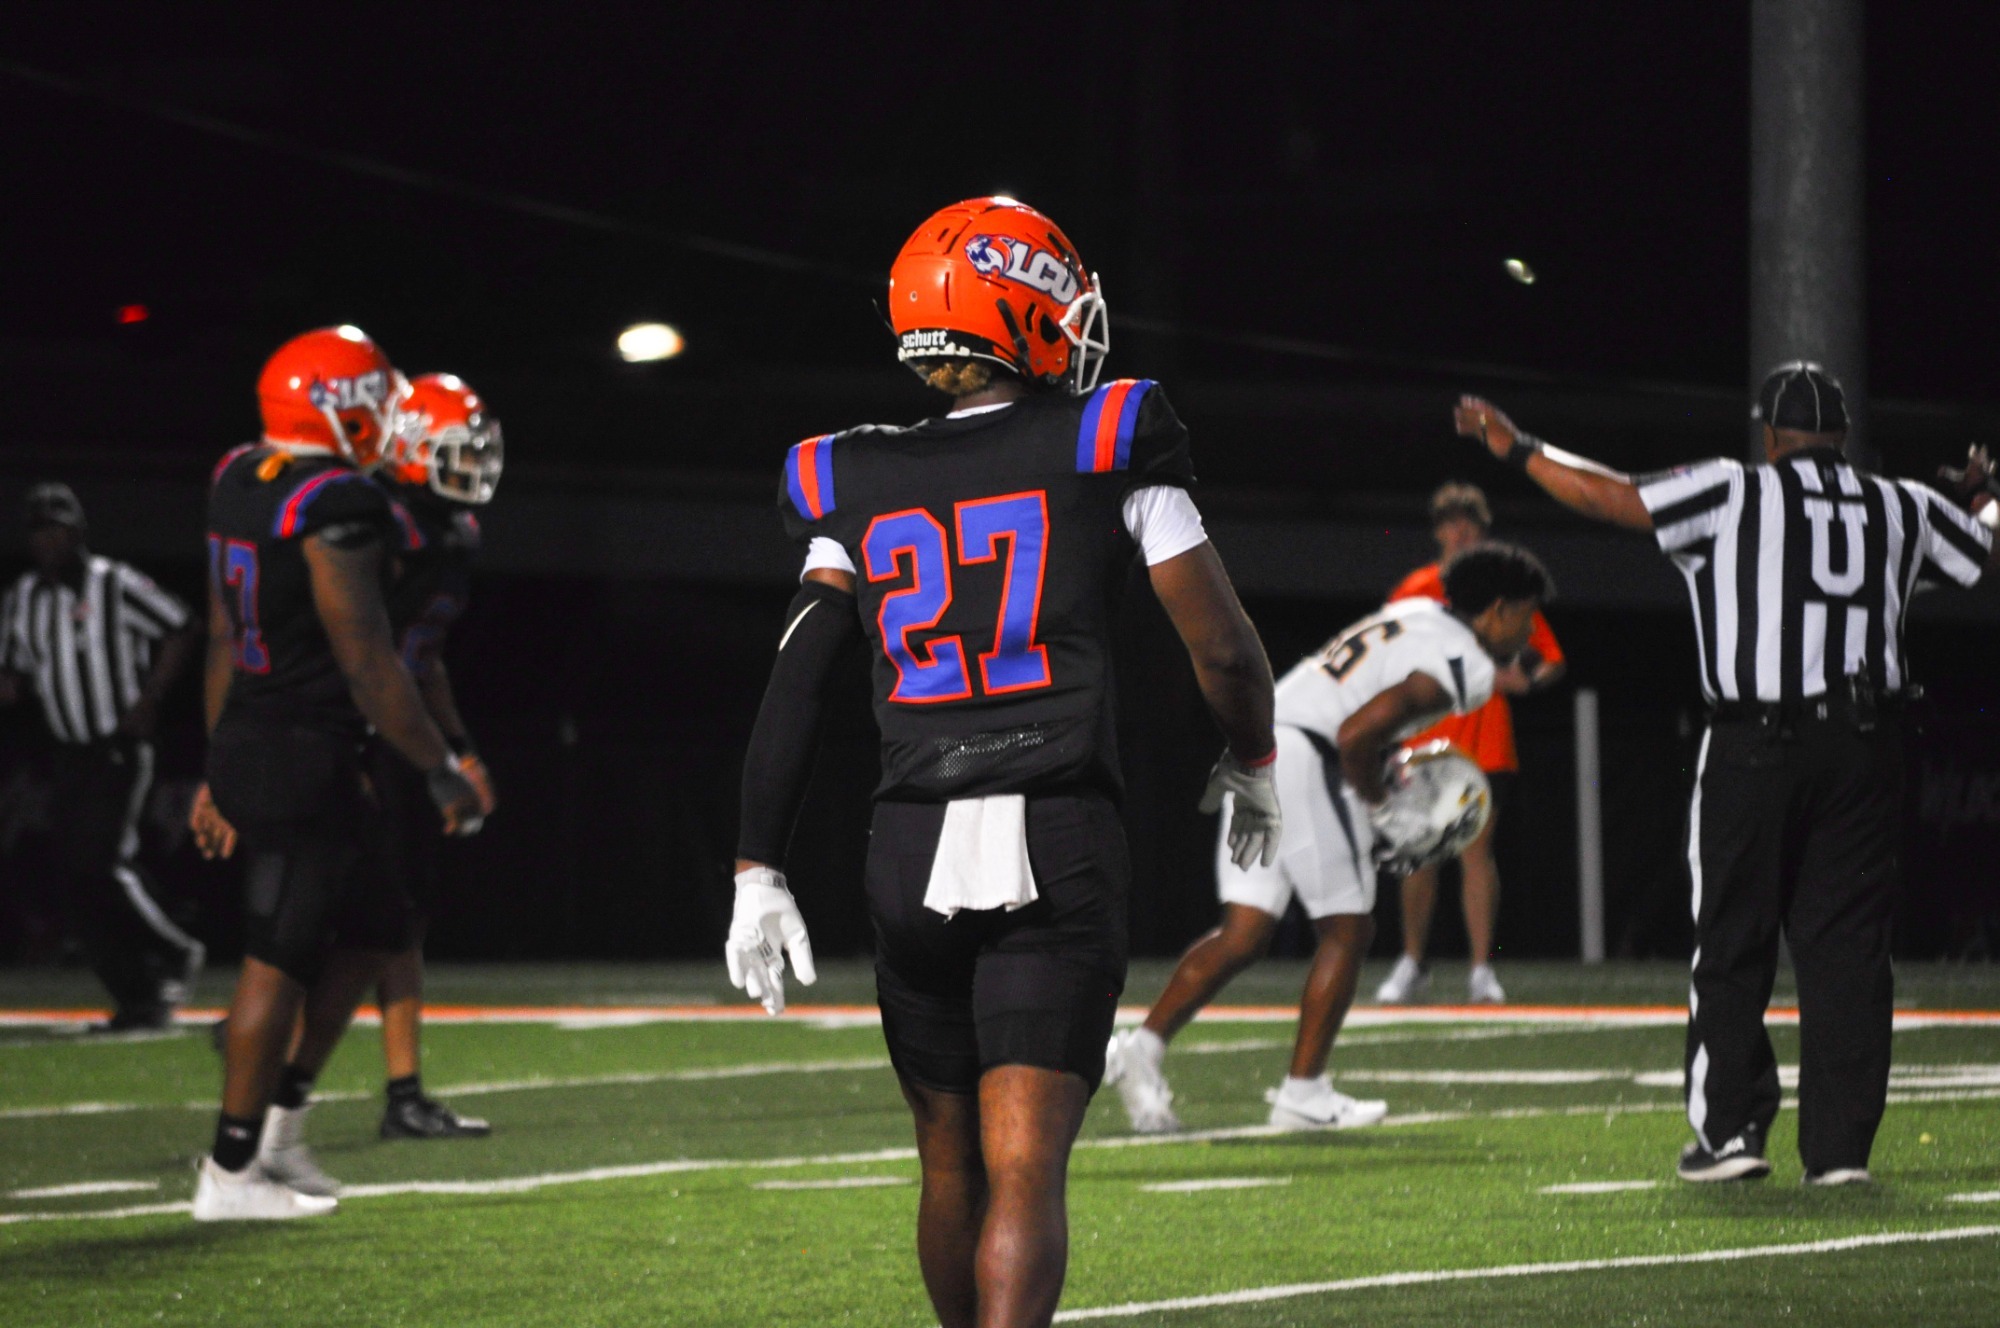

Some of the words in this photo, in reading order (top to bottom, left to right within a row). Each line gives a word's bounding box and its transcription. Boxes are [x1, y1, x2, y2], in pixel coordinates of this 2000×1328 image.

[1001, 241, 1078, 305] LCU
[902, 329, 947, 349] schutt
[1803, 496, 1868, 597] U
[861, 489, 1051, 704] 27
